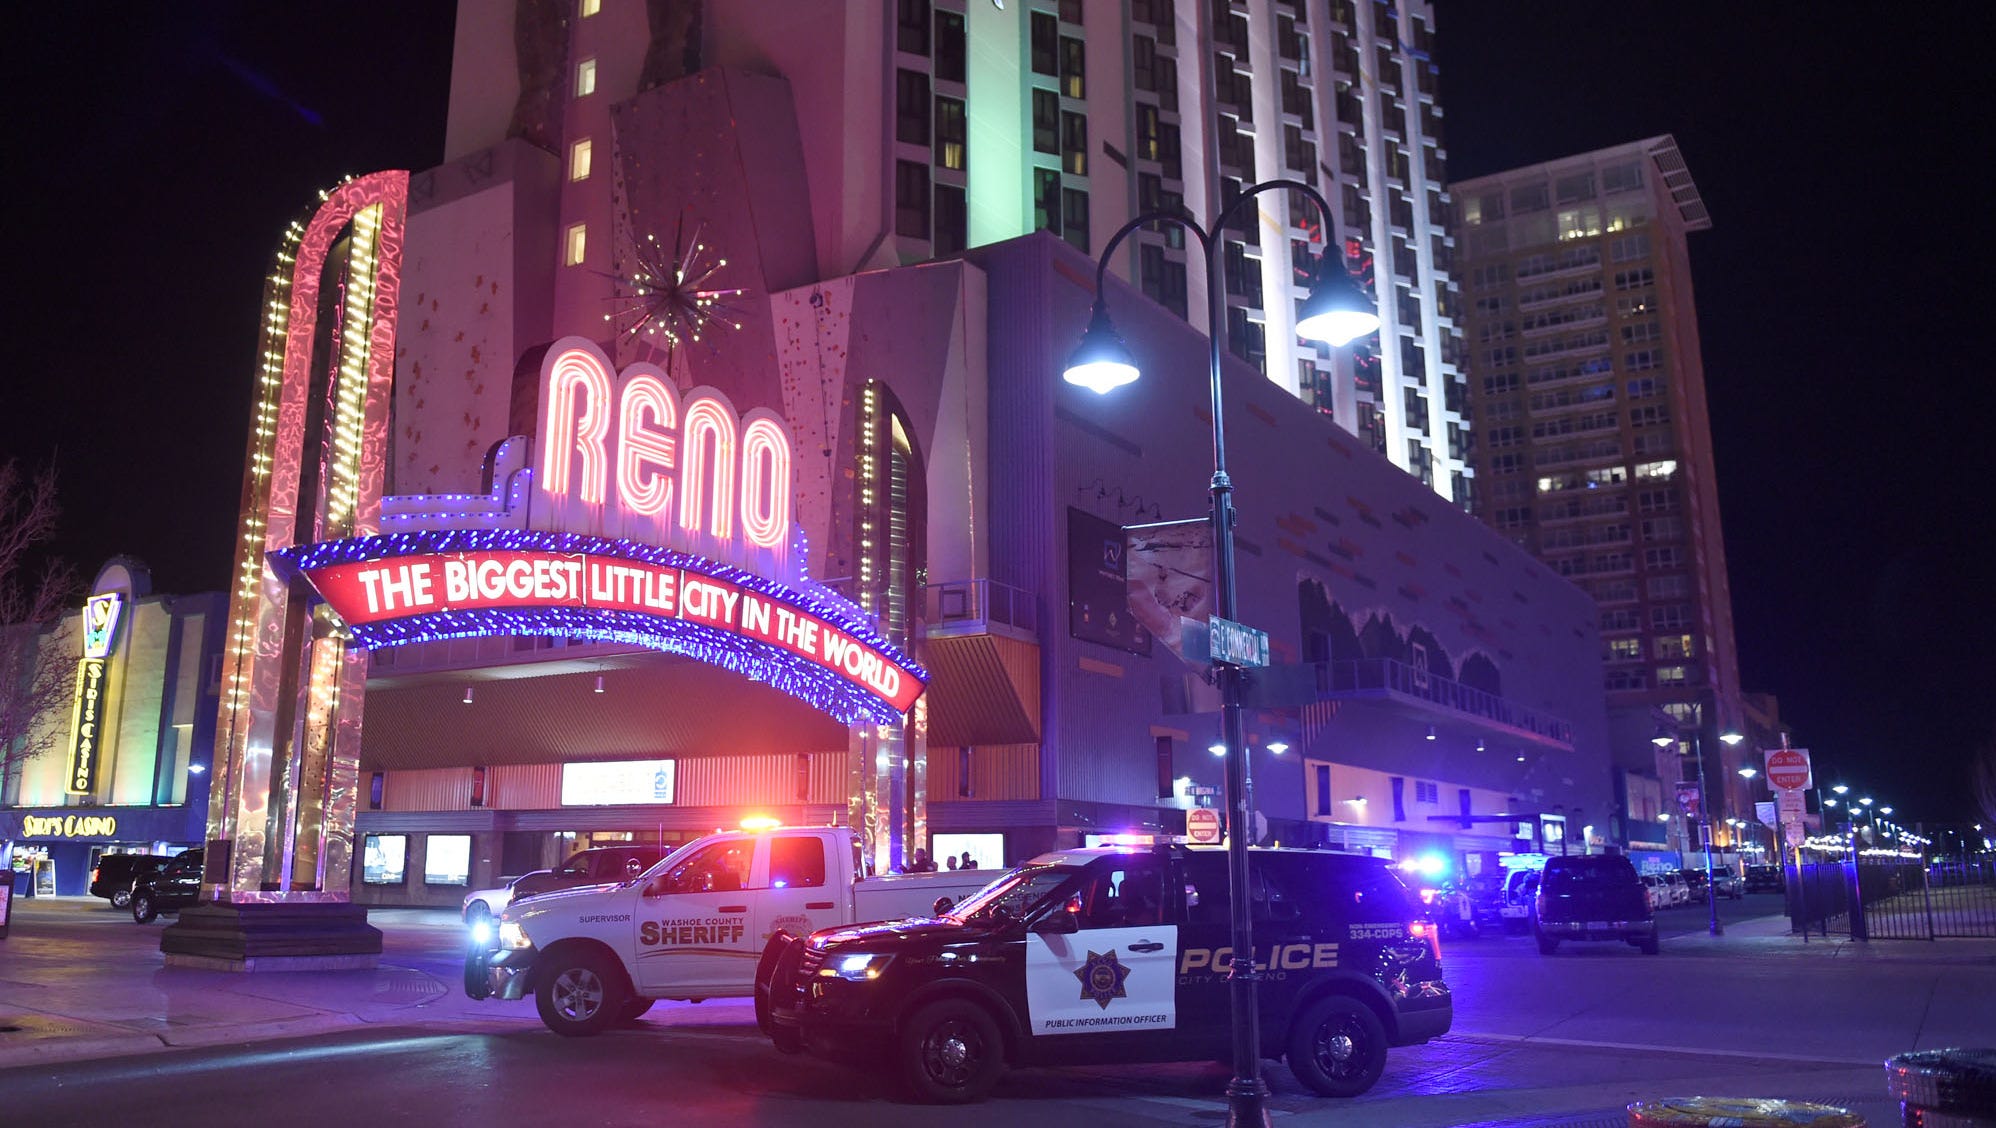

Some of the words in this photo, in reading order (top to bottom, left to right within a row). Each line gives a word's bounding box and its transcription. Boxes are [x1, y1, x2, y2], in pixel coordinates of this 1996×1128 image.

[542, 349, 791, 547] RENO
[357, 563, 434, 614] THE
[444, 560, 582, 602] BIGGEST
[591, 563, 674, 611] LITTLE
[683, 580, 739, 625] CITY
[741, 595, 770, 635] IN
[776, 607, 818, 655] THE
[823, 627, 900, 699] WORLD
[75, 722, 95, 790] CASINO
[1771, 756, 1783, 765] DO
[1786, 755, 1801, 764] NOT
[1776, 775, 1801, 784] ENTER
[64, 815, 116, 838] CASINO
[579, 914, 631, 924] SUPERVISOR
[661, 918, 702, 927] WASHOE
[705, 917, 744, 926] COUNTY
[640, 920, 744, 946] SHERIFF
[1350, 928, 1403, 940] 334-COPS
[1178, 975, 1213, 986] CITY
[1045, 1018, 1075, 1029] PUBLIC
[1075, 1016, 1132, 1027] INFORMATION
[1134, 1014, 1167, 1024] OFFICER
